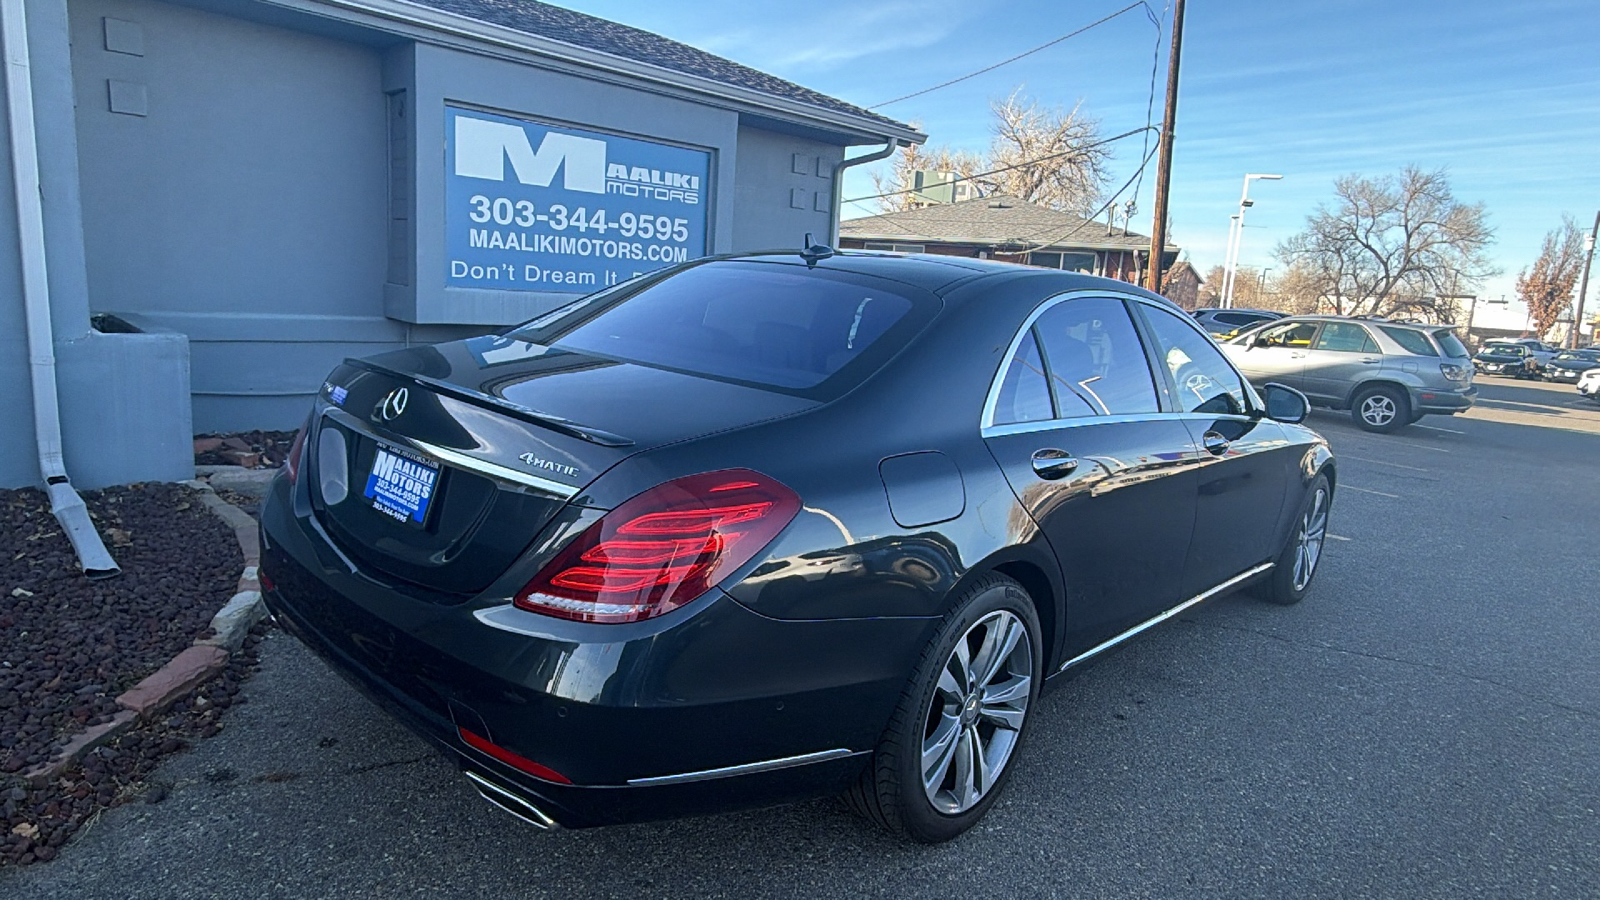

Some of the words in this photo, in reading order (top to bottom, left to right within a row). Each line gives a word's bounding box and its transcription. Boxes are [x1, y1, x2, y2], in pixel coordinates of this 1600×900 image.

[606, 181, 699, 205] MOTORS
[469, 195, 689, 242] 303-344-9595
[469, 228, 688, 263] MAALIKIMOTORS.COM
[451, 260, 515, 281] Don't
[525, 265, 596, 285] Dream
[373, 450, 435, 485] MAALIKI
[519, 452, 580, 477] 4MATIC
[376, 478, 420, 505] 303-344-9595
